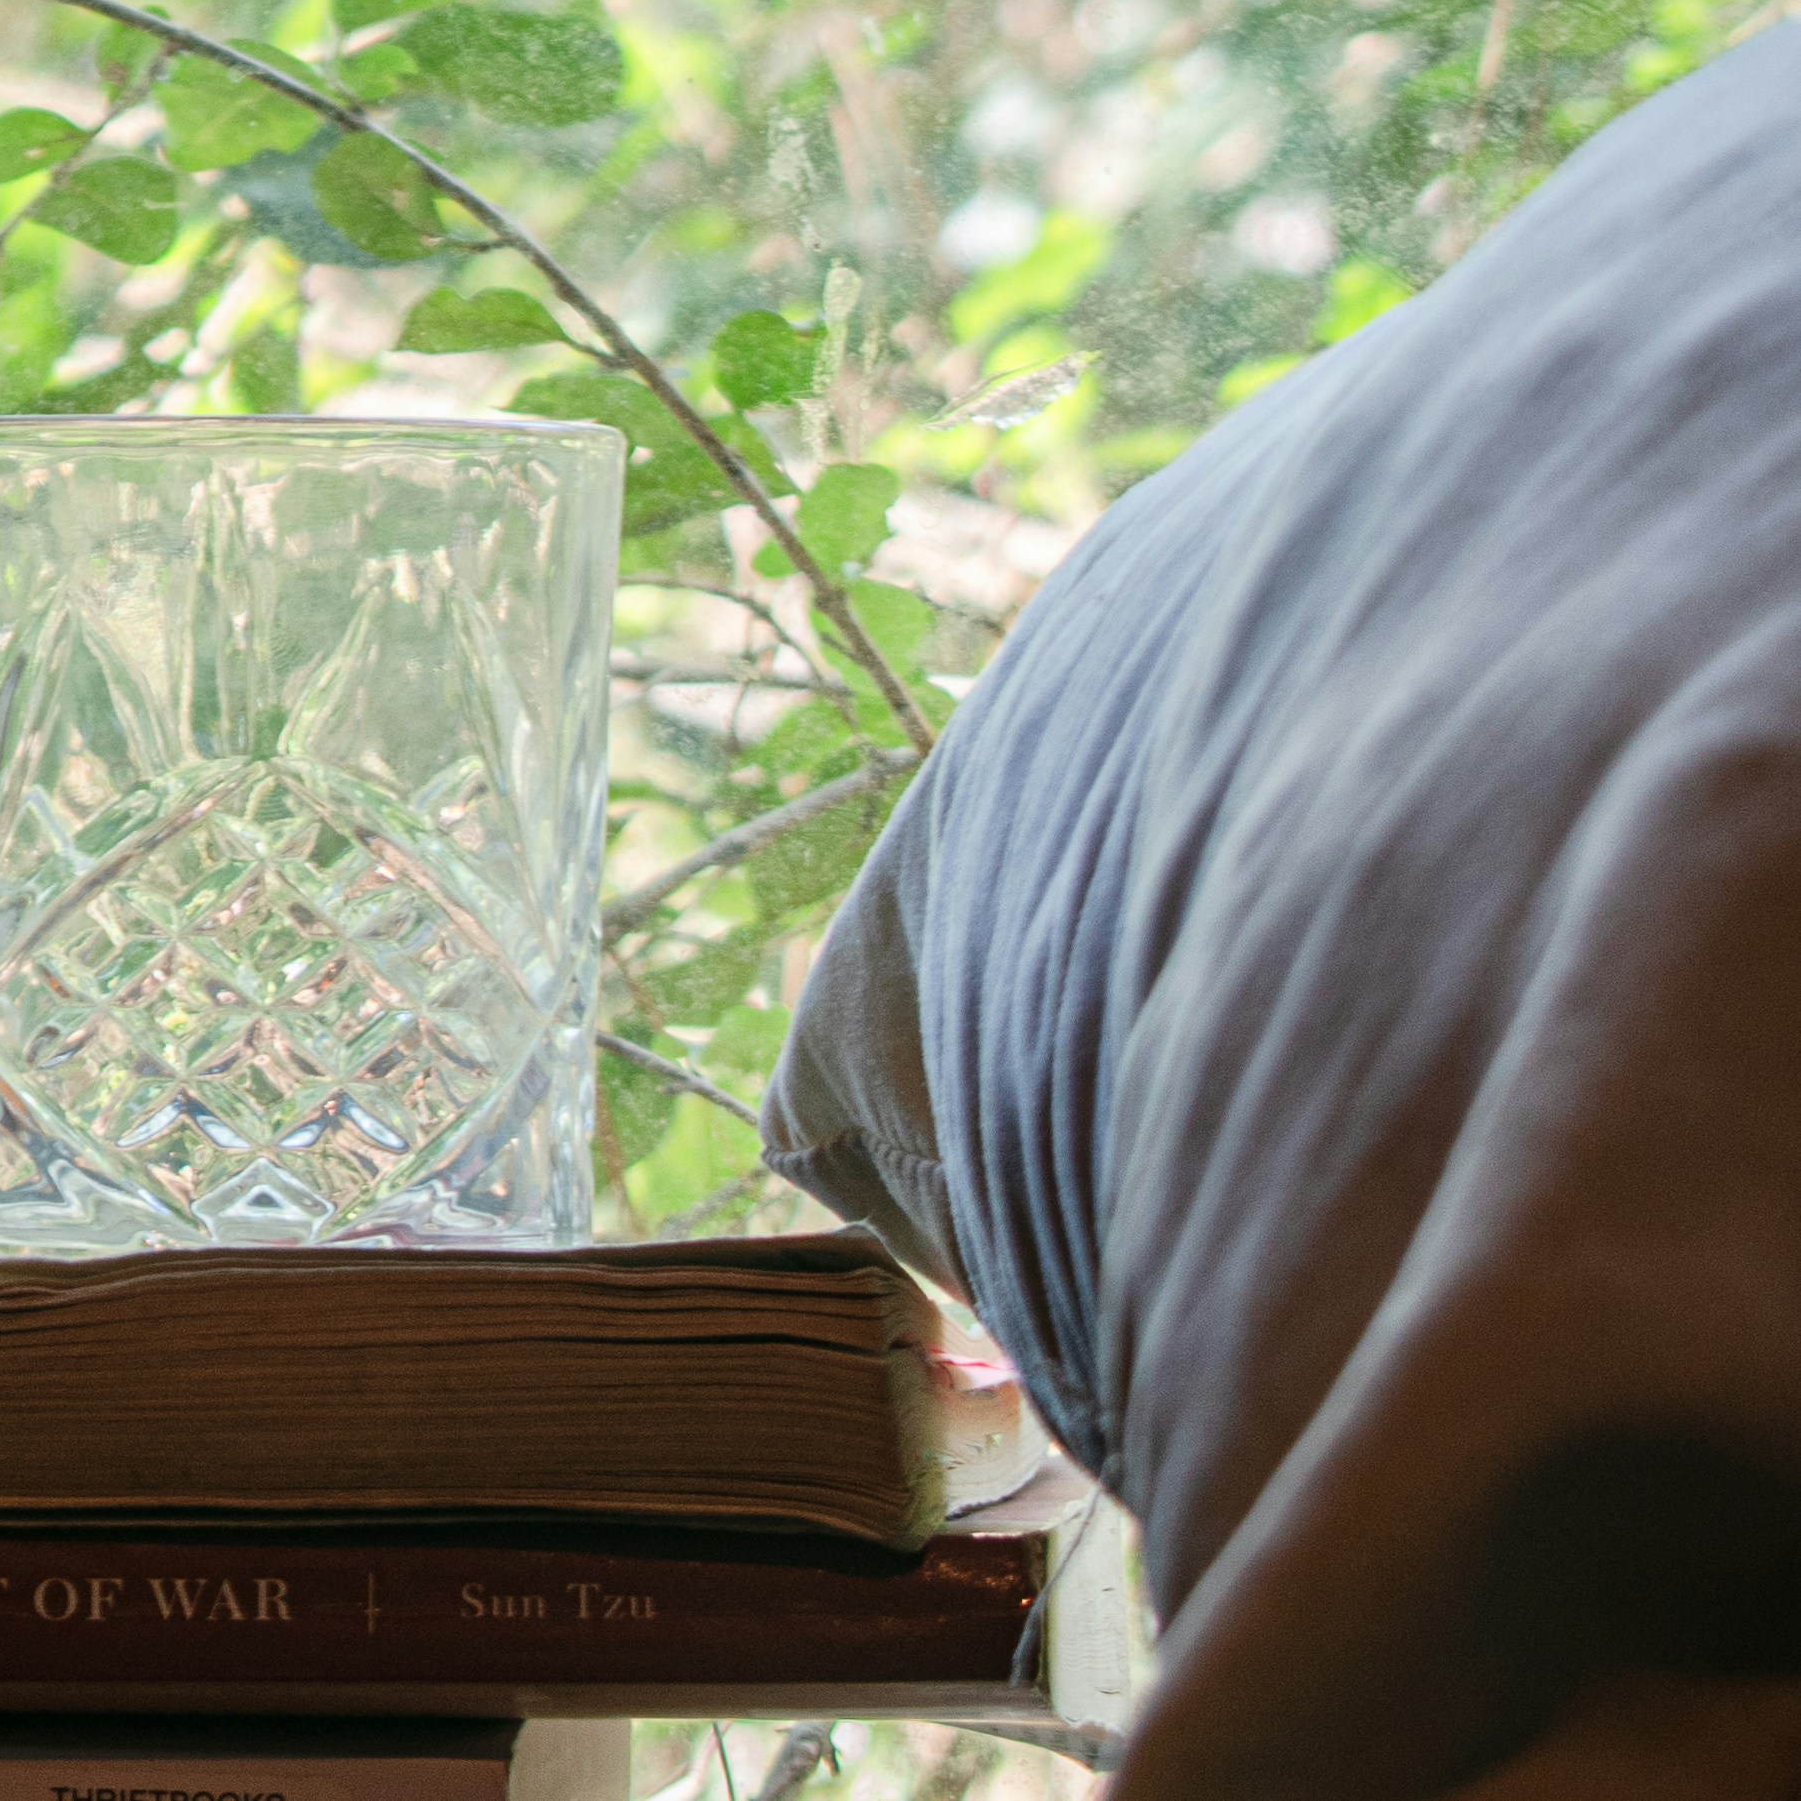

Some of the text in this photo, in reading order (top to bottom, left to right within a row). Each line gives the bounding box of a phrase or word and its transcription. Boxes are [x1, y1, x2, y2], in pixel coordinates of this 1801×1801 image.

[31, 1577, 125, 1621] OF
[146, 1577, 293, 1621] WAR
[460, 1581, 659, 1620] Sun Tzu
